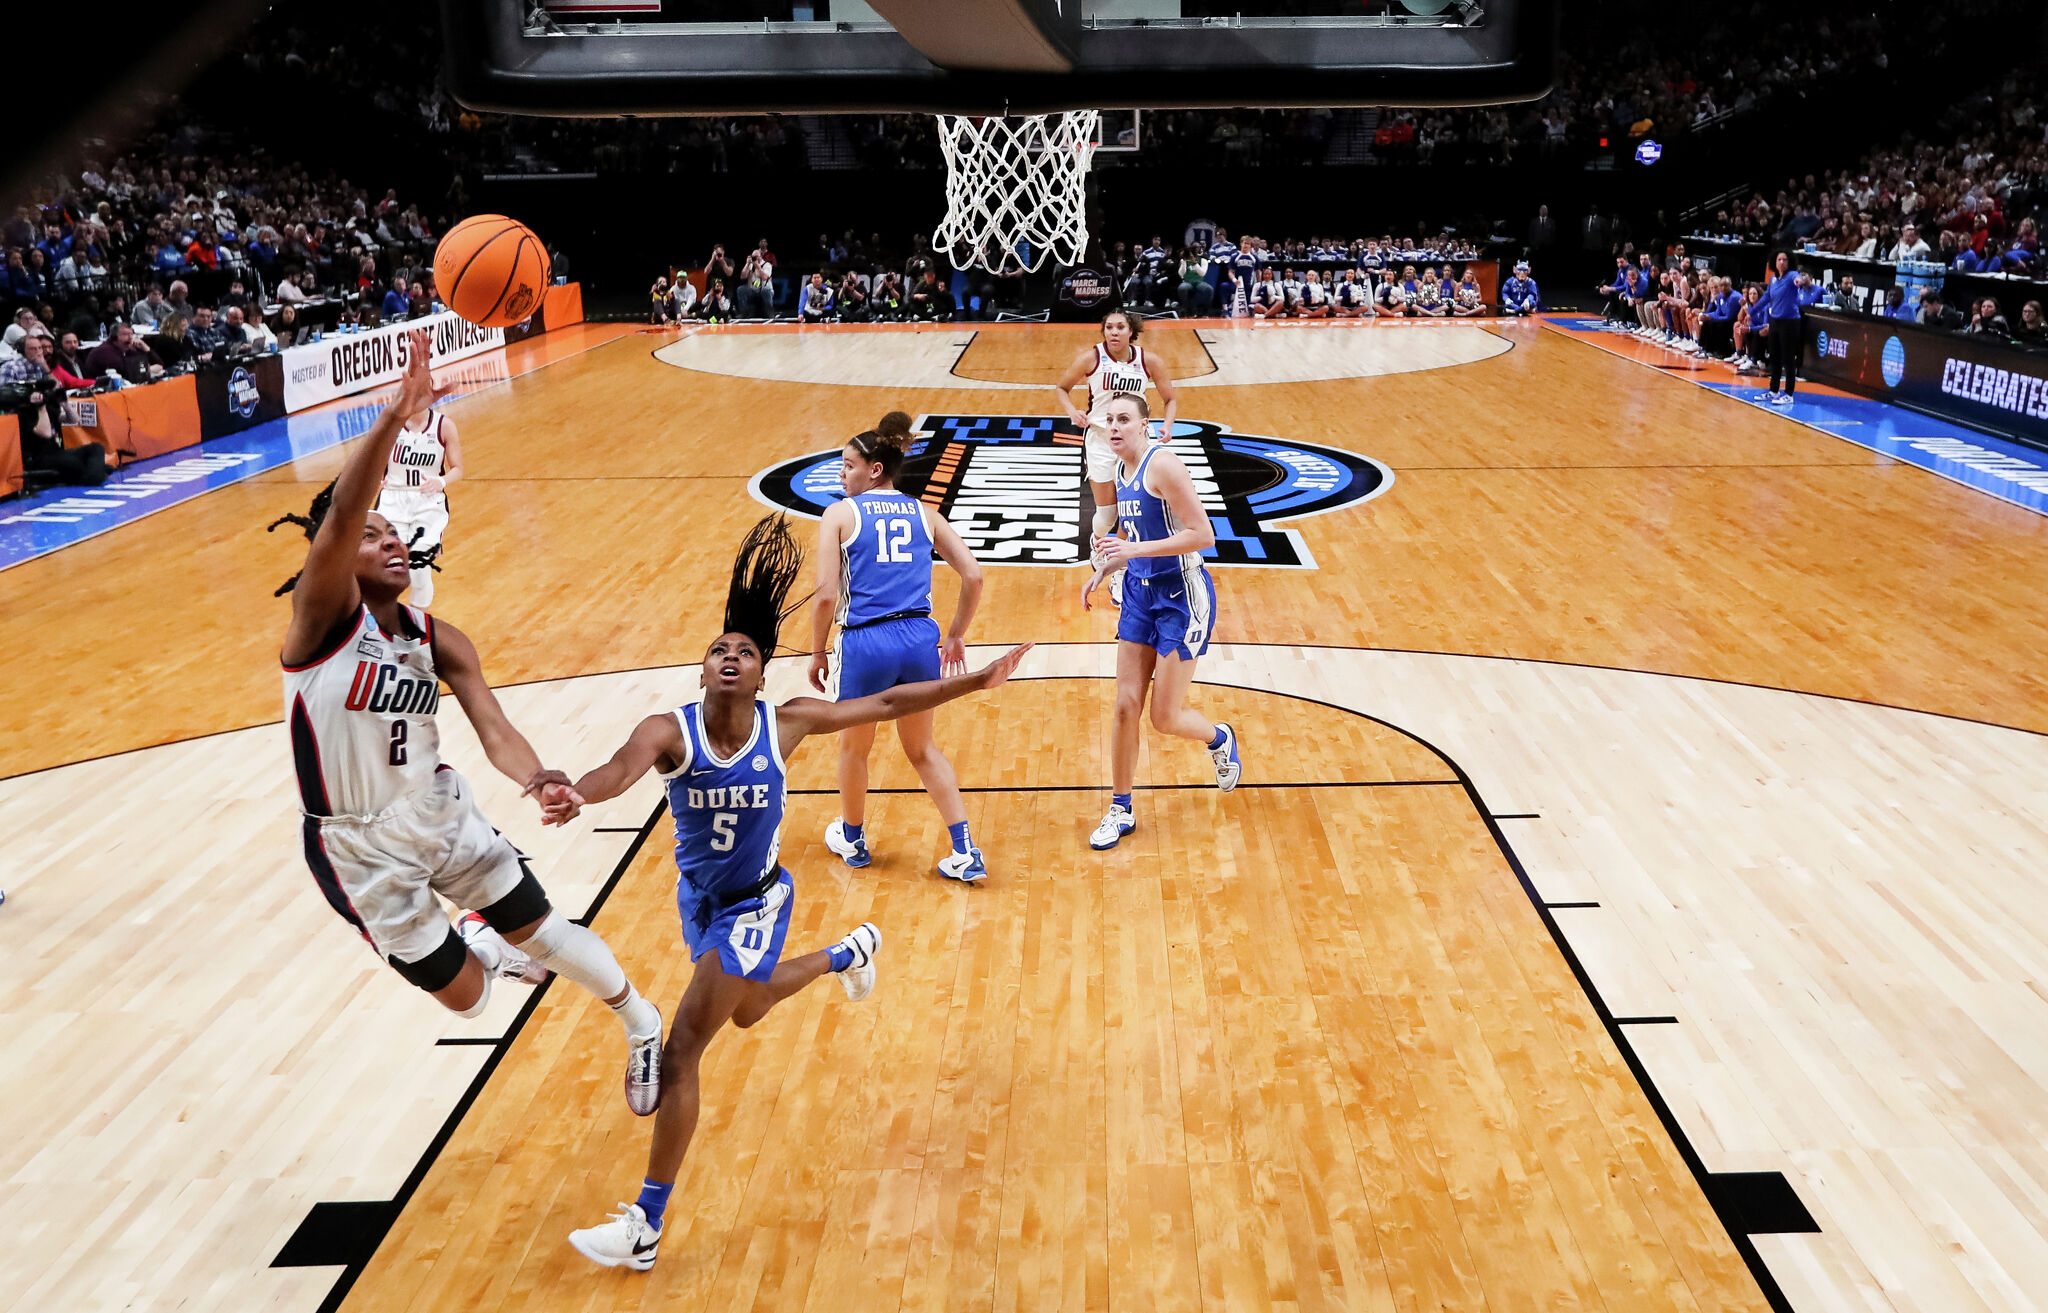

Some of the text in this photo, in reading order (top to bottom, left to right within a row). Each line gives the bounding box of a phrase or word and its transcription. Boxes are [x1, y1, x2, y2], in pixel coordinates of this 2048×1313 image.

[1072, 279, 1098, 287] MARCH
[1075, 286, 1110, 295] MADNESS
[1238, 287, 1246, 313] DUKE
[292, 366, 317, 384] HOSTED
[319, 363, 327, 378] BY
[332, 334, 393, 386] OREGON
[1828, 337, 1849, 358] AT&T
[1103, 372, 1142, 391] UConn
[1941, 357, 2048, 420] CELEBRATES
[392, 443, 436, 466] UConn
[406, 469, 420, 486] 10
[1264, 451, 1340, 488] SWEET 16
[862, 501, 917, 515] THOMAS
[938, 446, 1082, 560] MADNESS
[1117, 500, 1142, 517] UKE
[874, 518, 913, 563] 12
[345, 661, 440, 715] UConn
[389, 719, 408, 766] 2
[688, 784, 769, 809] DUKE
[710, 812, 738, 852] 5
